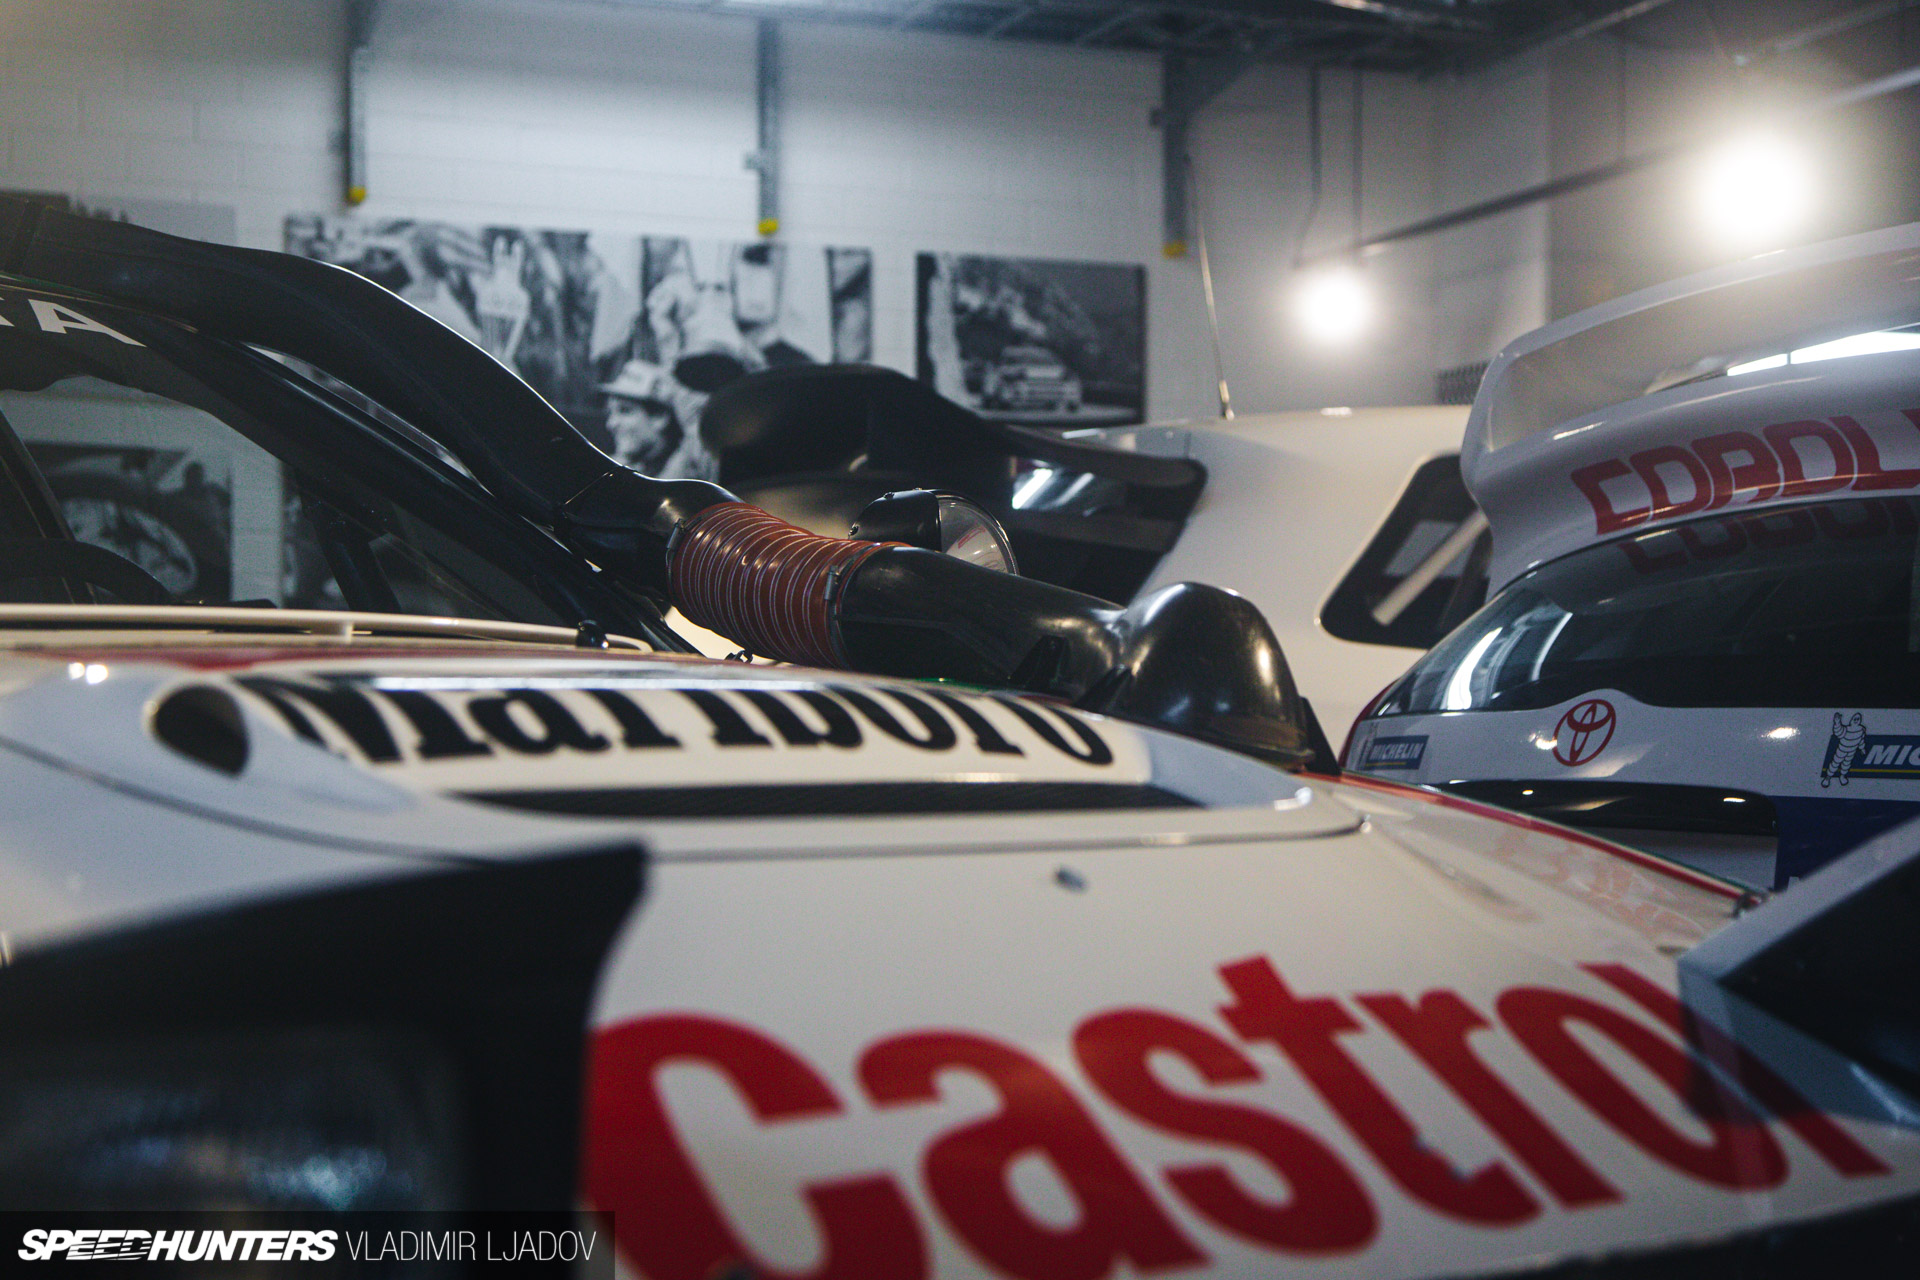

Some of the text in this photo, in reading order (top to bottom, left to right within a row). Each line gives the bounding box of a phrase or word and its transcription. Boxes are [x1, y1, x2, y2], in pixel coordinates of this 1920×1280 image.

[0, 297, 147, 347] A
[1571, 408, 1920, 535] COROL
[1369, 743, 1425, 761] MICHELIN
[582, 955, 1894, 1280] Castrol
